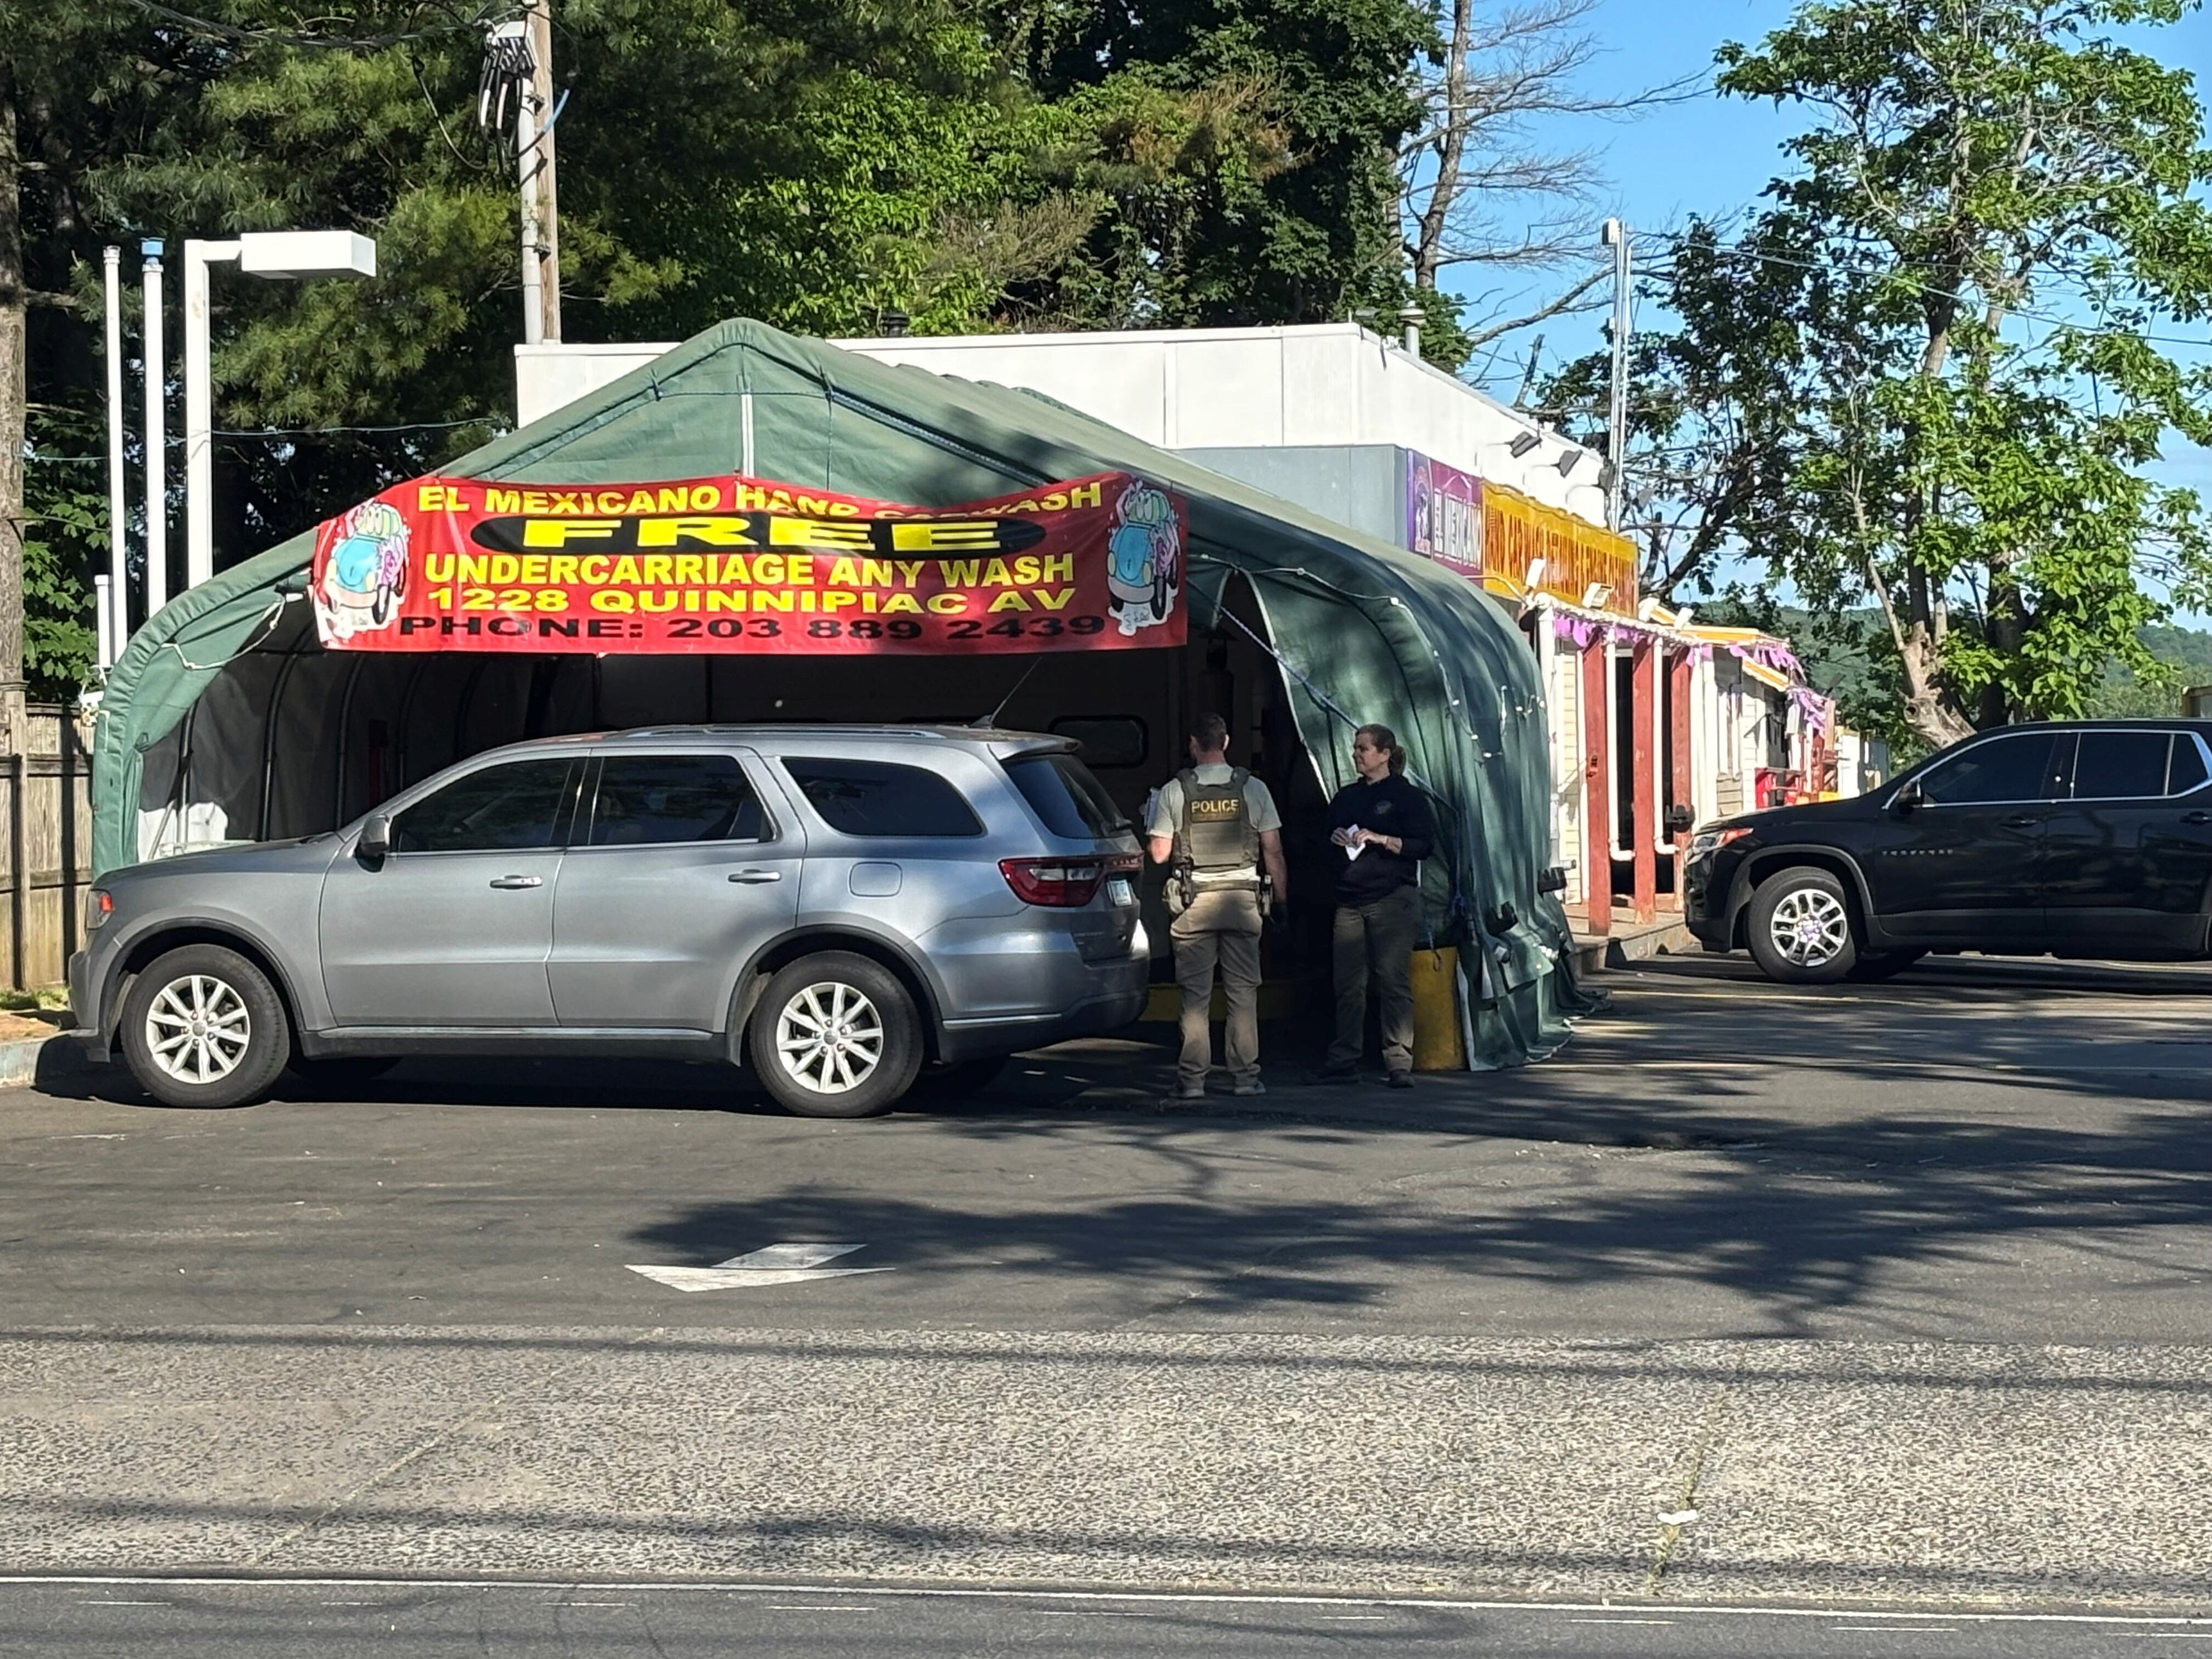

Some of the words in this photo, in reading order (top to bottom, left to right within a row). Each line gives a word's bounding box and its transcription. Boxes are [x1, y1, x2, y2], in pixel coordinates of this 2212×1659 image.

[419, 486, 470, 512] EL
[485, 488, 721, 515] MEXICANO
[736, 485, 860, 517] HAND
[523, 516, 1000, 552] FREE
[426, 553, 815, 585] UNDERCARRIAGE
[828, 556, 923, 587] ANY
[940, 554, 1073, 587] WASH
[428, 587, 568, 612] 1228
[590, 590, 967, 614] QUINNIPIAC
[987, 588, 1076, 613] AV
[401, 616, 643, 638] PHONE:
[668, 619, 782, 638] 203
[807, 620, 922, 639] 889
[947, 618, 1105, 639] 2439
[1191, 799, 1239, 813] POLICE
